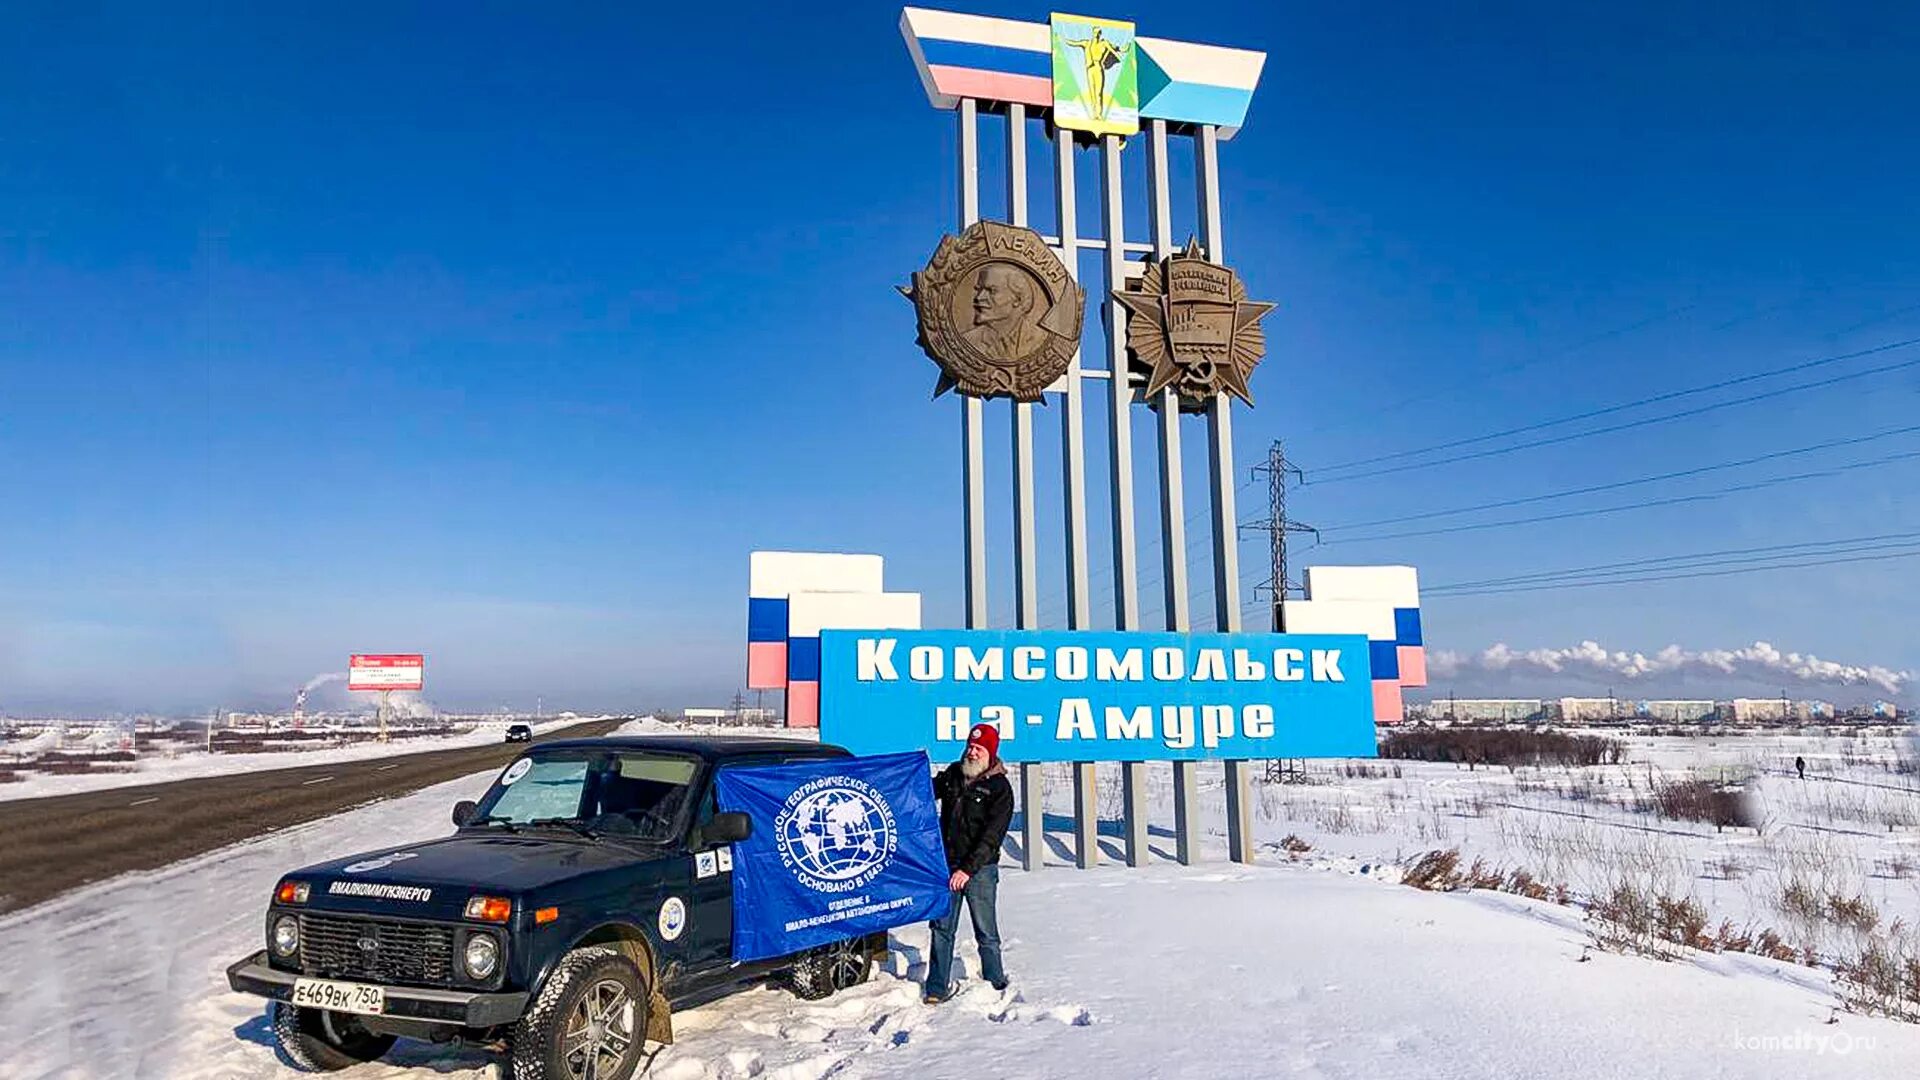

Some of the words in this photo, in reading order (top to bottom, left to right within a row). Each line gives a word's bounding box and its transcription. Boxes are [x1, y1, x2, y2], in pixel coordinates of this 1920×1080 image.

[993, 234, 1066, 284] ЛЕНИН
[857, 639, 1346, 682] Комсомольск
[774, 807, 793, 868] РУССКОЕ
[785, 776, 869, 814] ГЕОГРАФИЧЕСКОЕ
[869, 788, 898, 852] ОБЩЕСТВО
[797, 873, 855, 892] ОСНОВАНО
[855, 877, 864, 888] В
[863, 863, 884, 882] 1845
[355, 986, 379, 1004] 750
